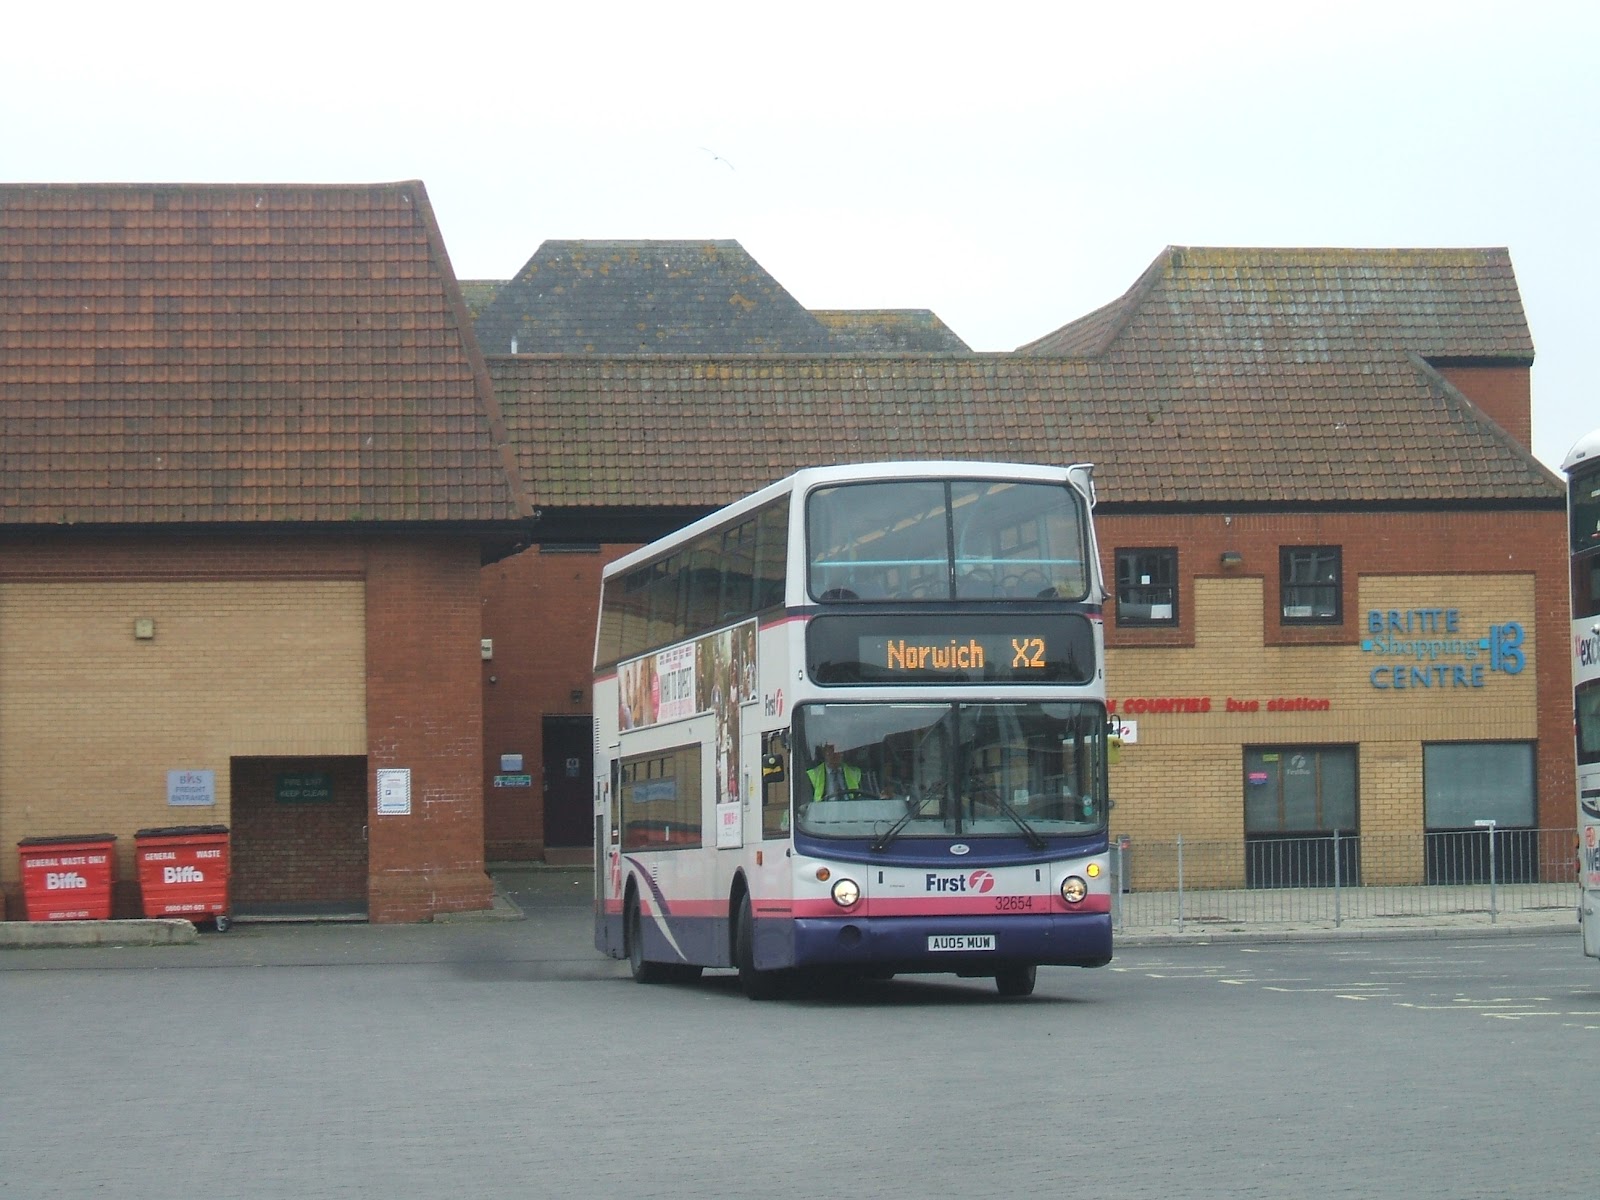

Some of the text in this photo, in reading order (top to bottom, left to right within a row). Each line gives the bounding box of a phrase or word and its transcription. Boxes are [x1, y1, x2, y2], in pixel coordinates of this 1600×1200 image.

[1368, 609, 1459, 633] BRITTE
[887, 638, 1045, 669] Norwich X2
[1373, 634, 1479, 660] Shopping
[1370, 664, 1484, 689] CENTRE
[1123, 696, 1211, 714] COUNTIES
[1226, 697, 1260, 713] bus
[1267, 697, 1330, 712] station
[280, 789, 328, 797] KEEP CLEAR
[26, 855, 106, 868] GENERAL WASTE ONLY
[145, 850, 221, 861] GENERAL WASTE
[47, 872, 87, 890] Biffa
[164, 865, 204, 884] Biffa
[926, 873, 966, 891] First
[995, 895, 1033, 911] 32654
[933, 937, 991, 950] AU05 MUW
